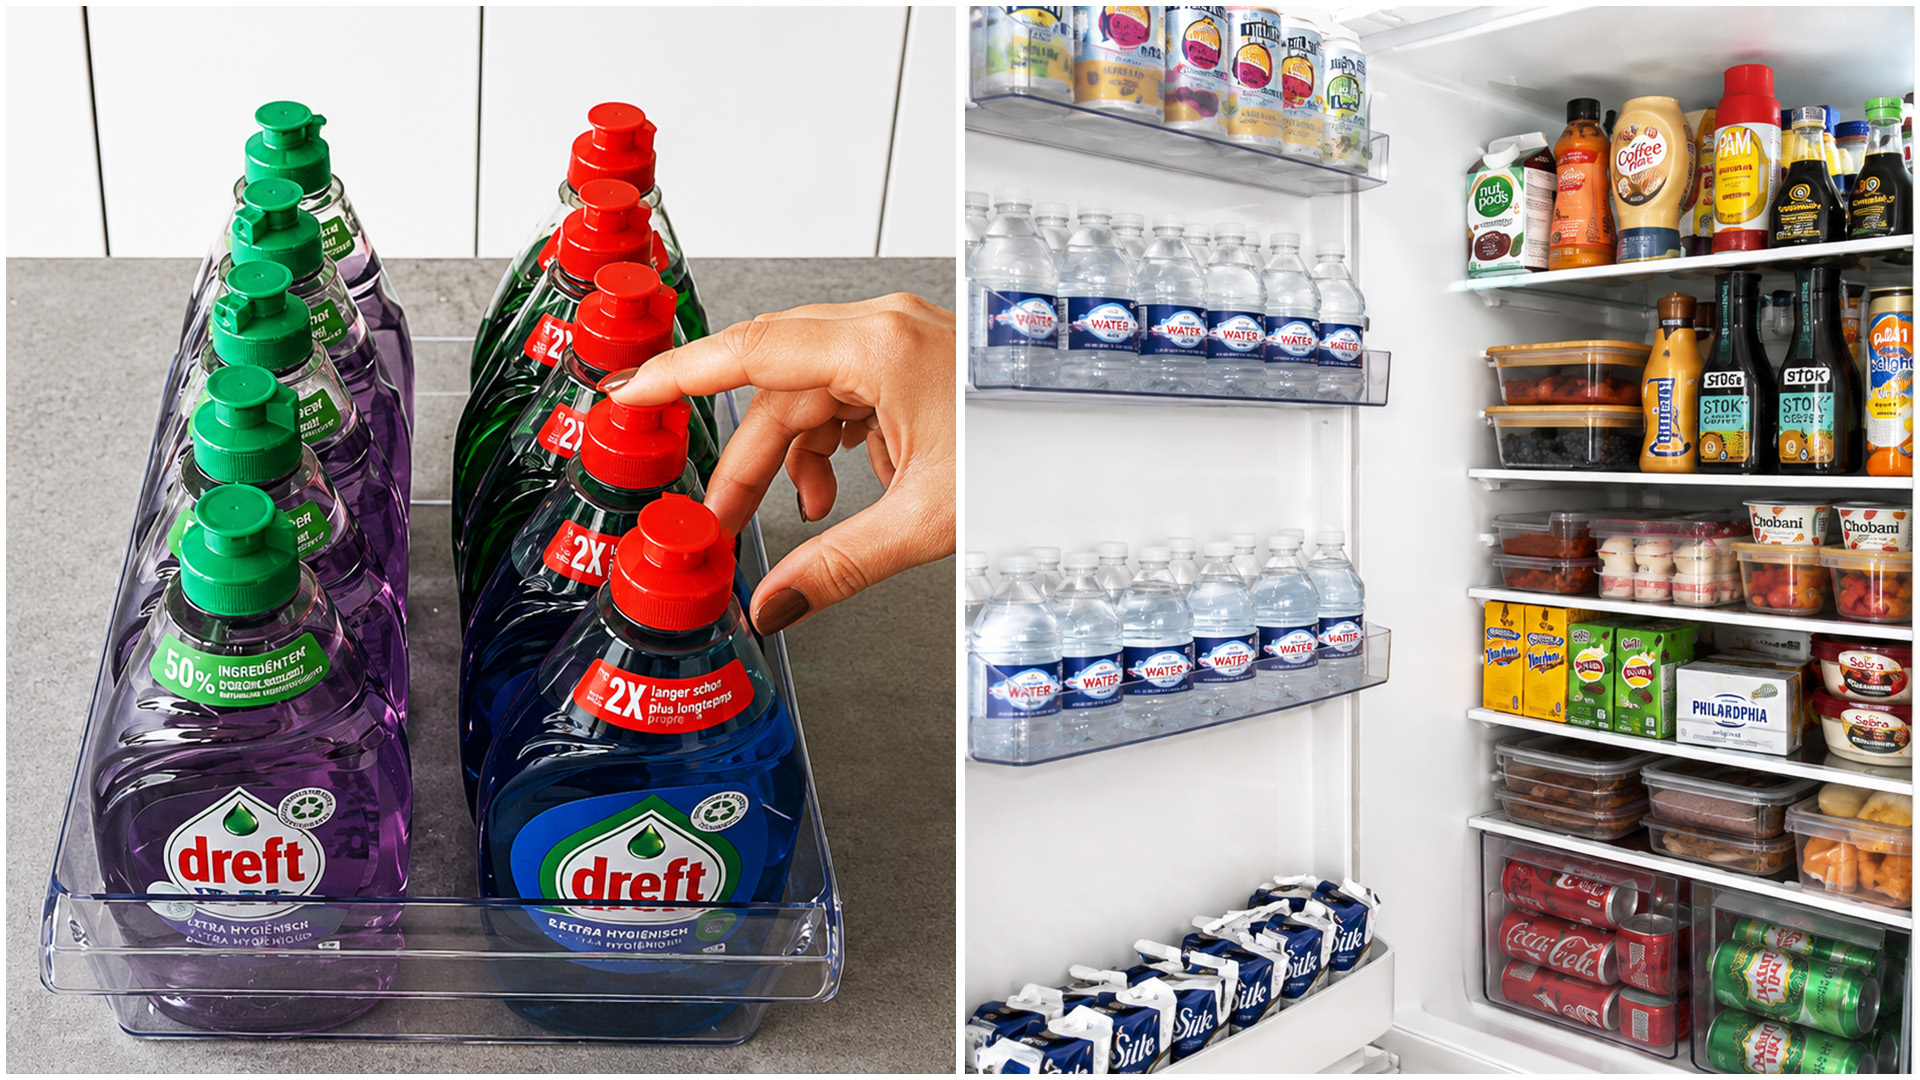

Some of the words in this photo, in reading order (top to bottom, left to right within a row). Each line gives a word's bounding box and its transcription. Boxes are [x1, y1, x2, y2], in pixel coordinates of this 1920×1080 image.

[1719, 129, 1752, 158] PAM
[1618, 142, 1662, 166] Coffee
[1480, 182, 1501, 197] nut
[1223, 330, 1258, 342] WATER
[1703, 398, 1743, 414] STOK
[1753, 515, 1803, 529] Chobani
[1844, 519, 1900, 534] Chobani
[570, 533, 606, 577] 2X
[1214, 654, 1249, 667] WATER
[164, 647, 216, 695] 50%
[1145, 664, 1184, 678] WATER
[1083, 674, 1118, 688] WATER
[604, 676, 648, 721] 2X
[651, 684, 691, 702] langer
[1007, 684, 1052, 698] WATER
[649, 702, 674, 715] plus
[178, 836, 306, 885] dreft
[571, 855, 708, 906] dreft
[1171, 1007, 1214, 1042] Silk
